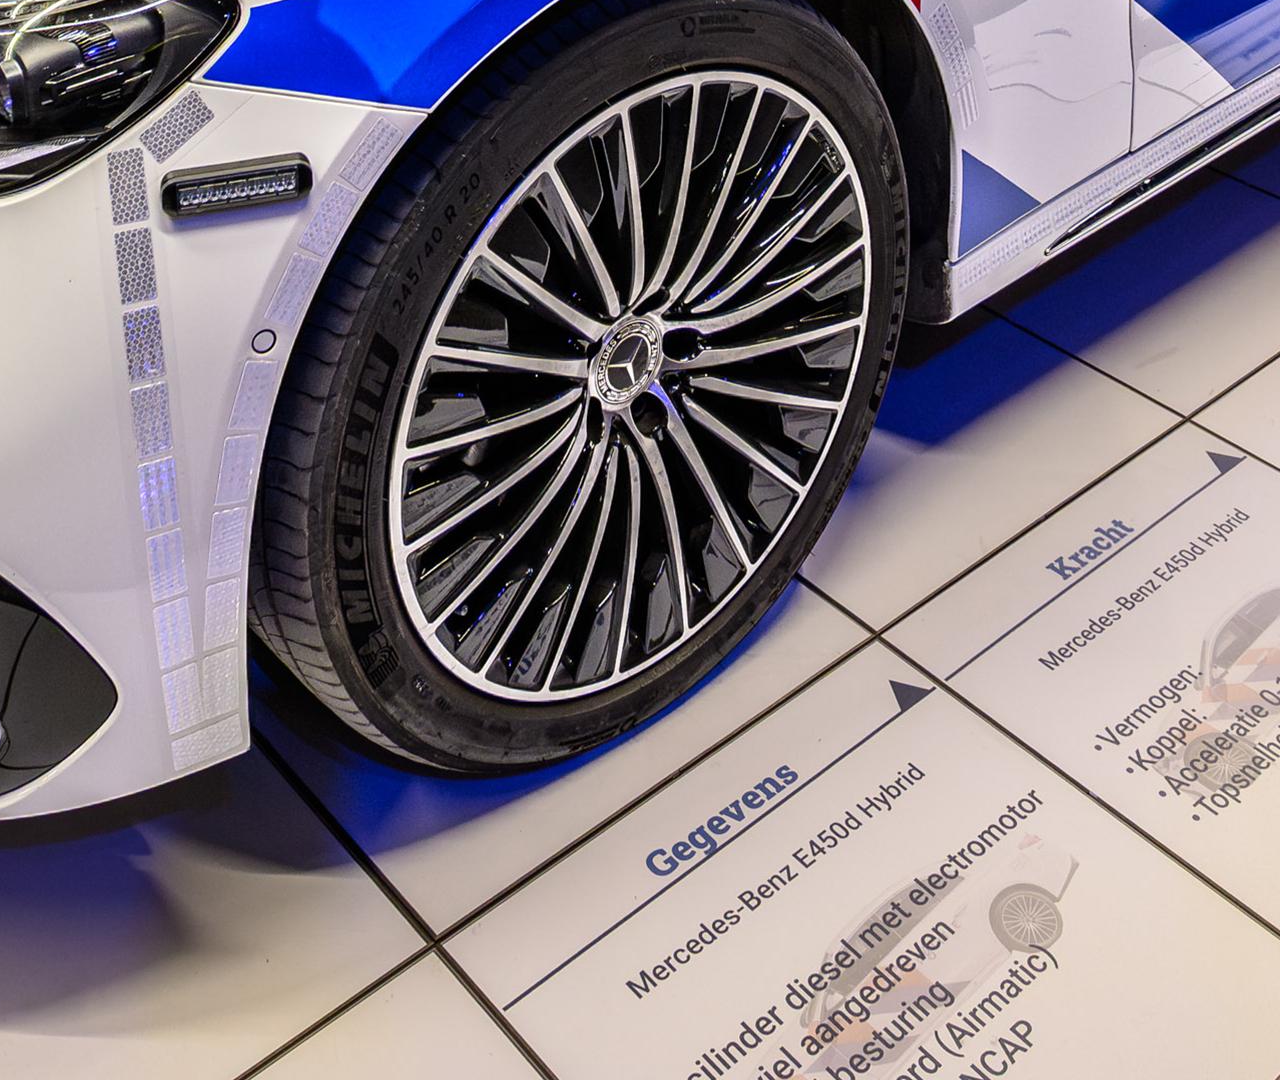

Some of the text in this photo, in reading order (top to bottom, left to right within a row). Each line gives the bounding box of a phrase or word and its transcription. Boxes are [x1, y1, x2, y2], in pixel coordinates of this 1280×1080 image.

[334, 352, 393, 626] MICHELIN
[1038, 507, 1250, 671] Mercedes-Benz E450d Hybrid
[1045, 519, 1135, 581] Kracht
[1095, 664, 1204, 750] Vermogen:
[1129, 705, 1208, 772] Koppel:
[1162, 699, 1270, 797] Acceleratie
[645, 763, 799, 877] Gegevens
[625, 761, 926, 1000] Mercedes-Benz E450d Hybrid
[785, 940, 863, 1011] diesel
[859, 901, 914, 949] met
[908, 789, 1044, 908] electromotor
[800, 918, 955, 1057] aangedreven
[934, 944, 1059, 1058] (Airmatic)
